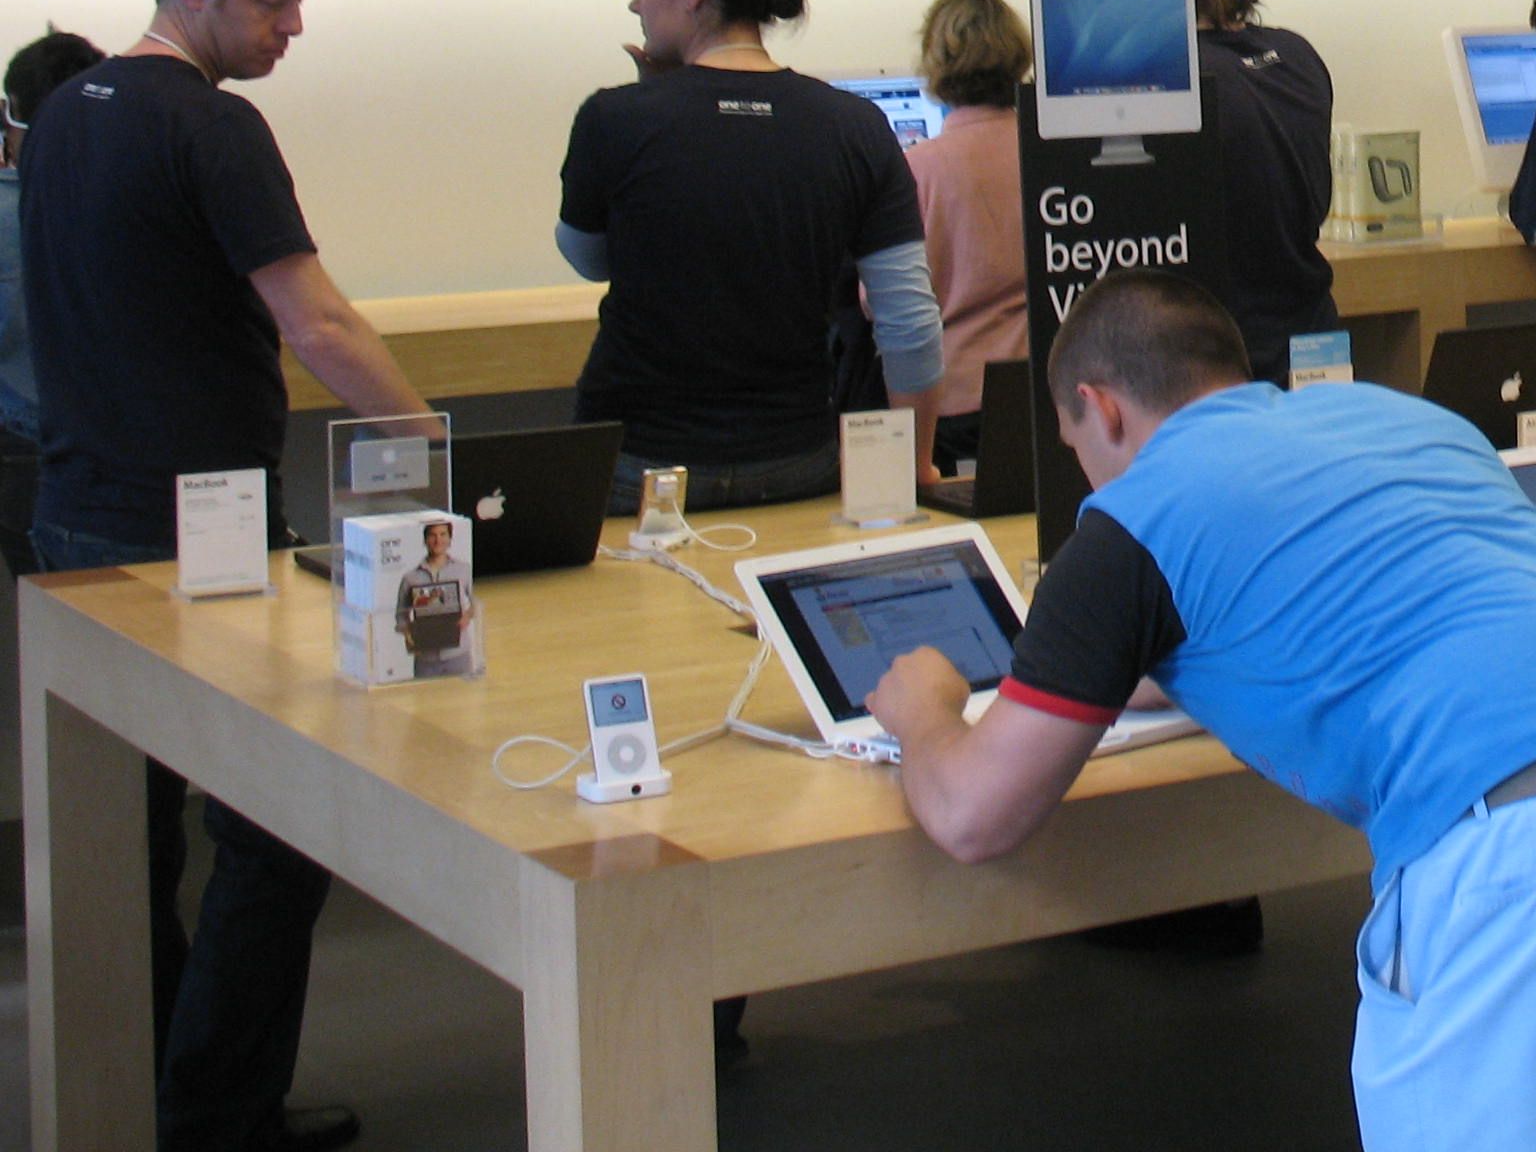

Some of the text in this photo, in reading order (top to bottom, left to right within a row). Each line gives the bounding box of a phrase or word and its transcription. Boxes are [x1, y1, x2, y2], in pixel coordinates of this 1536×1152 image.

[1039, 186, 1094, 226] Go
[1045, 222, 1189, 280] beyond
[184, 478, 228, 490] MacBook
